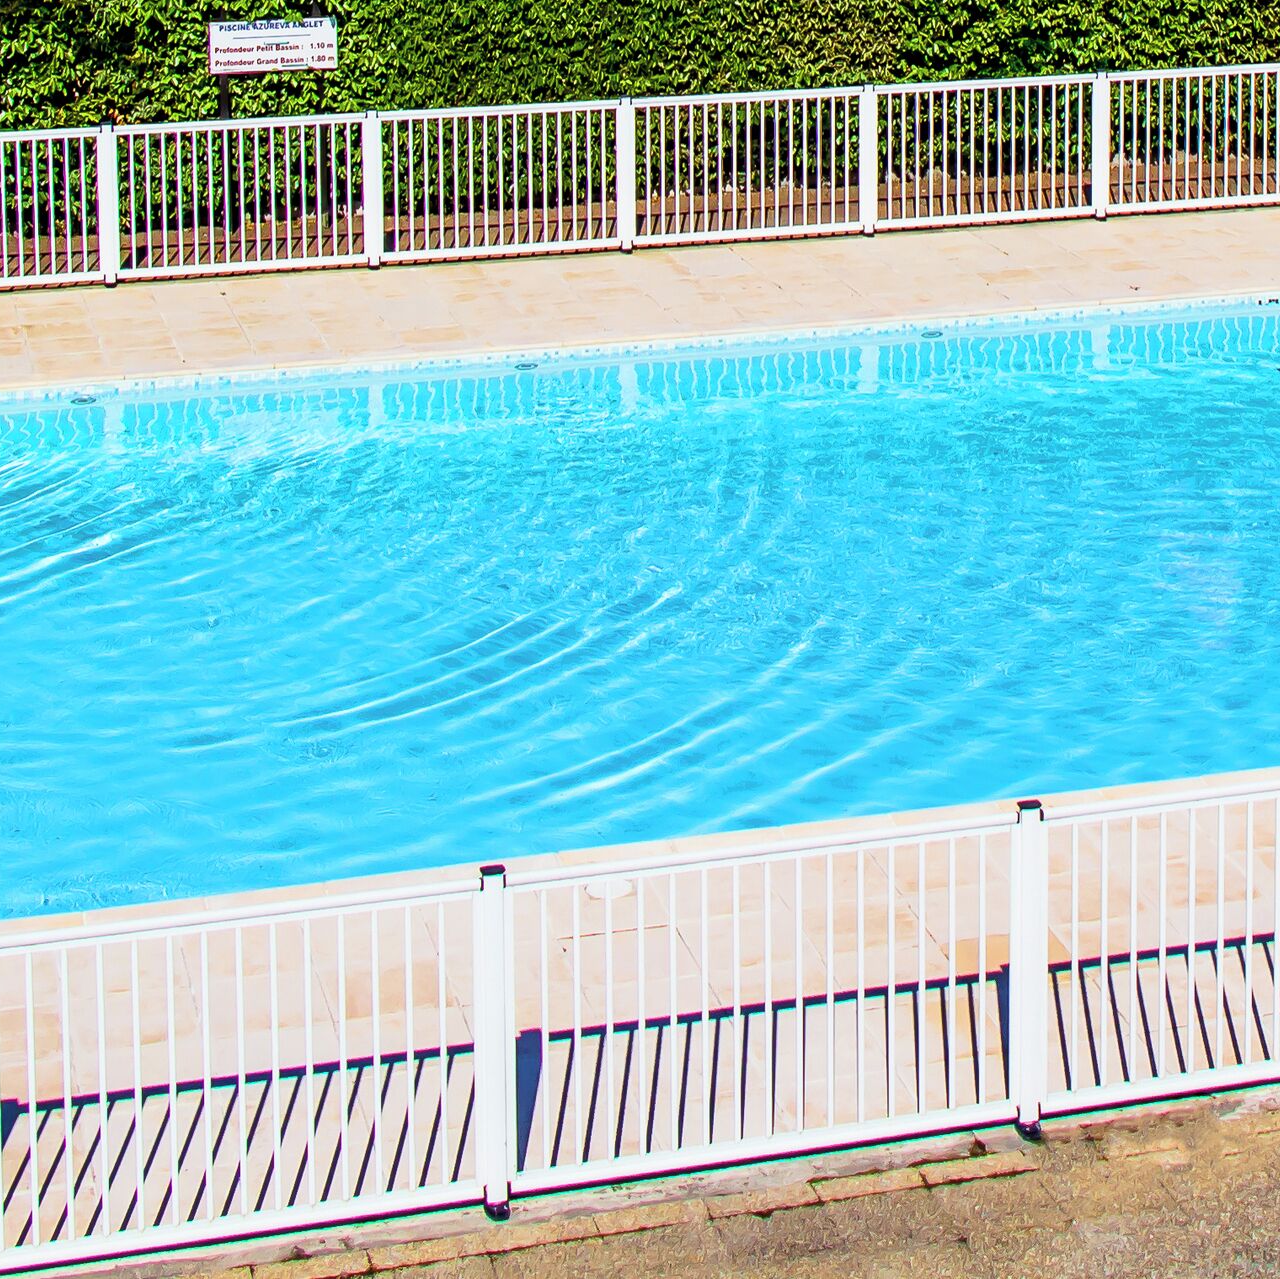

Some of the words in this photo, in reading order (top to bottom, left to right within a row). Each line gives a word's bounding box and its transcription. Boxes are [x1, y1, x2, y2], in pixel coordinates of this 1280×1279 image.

[219, 23, 251, 32] PISCINE
[253, 21, 291, 30] AZUREVA
[215, 46, 254, 54] Profondeur
[257, 44, 273, 52] Petit
[275, 43, 300, 51] Bassin
[310, 41, 325, 49] 1.10
[215, 59, 254, 67] Profondeur
[256, 57, 279, 65] Grand
[280, 56, 305, 64] Bassin
